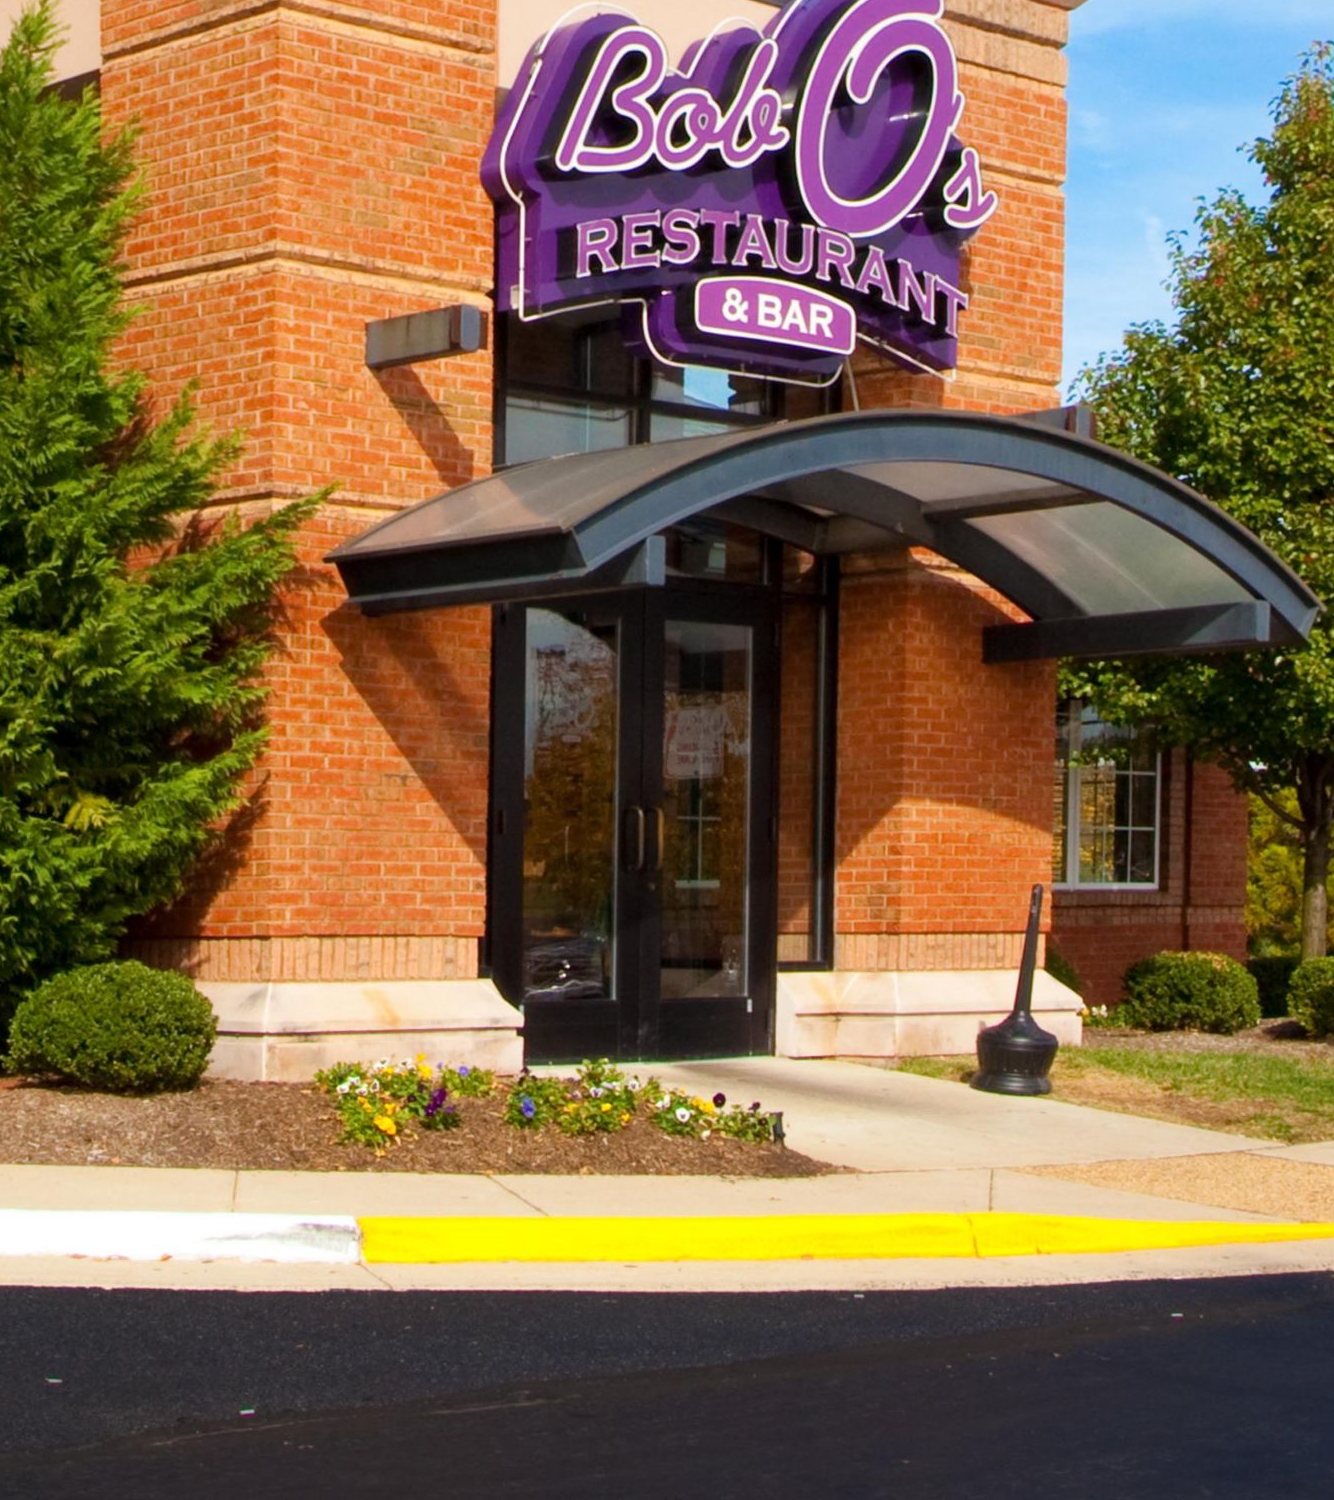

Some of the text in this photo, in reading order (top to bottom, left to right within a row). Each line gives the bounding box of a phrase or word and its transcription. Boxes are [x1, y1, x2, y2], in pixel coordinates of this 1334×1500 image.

[555, 23, 789, 173] Bob
[575, 207, 968, 338] RESTAURANT
[722, 287, 834, 338] & BAR
